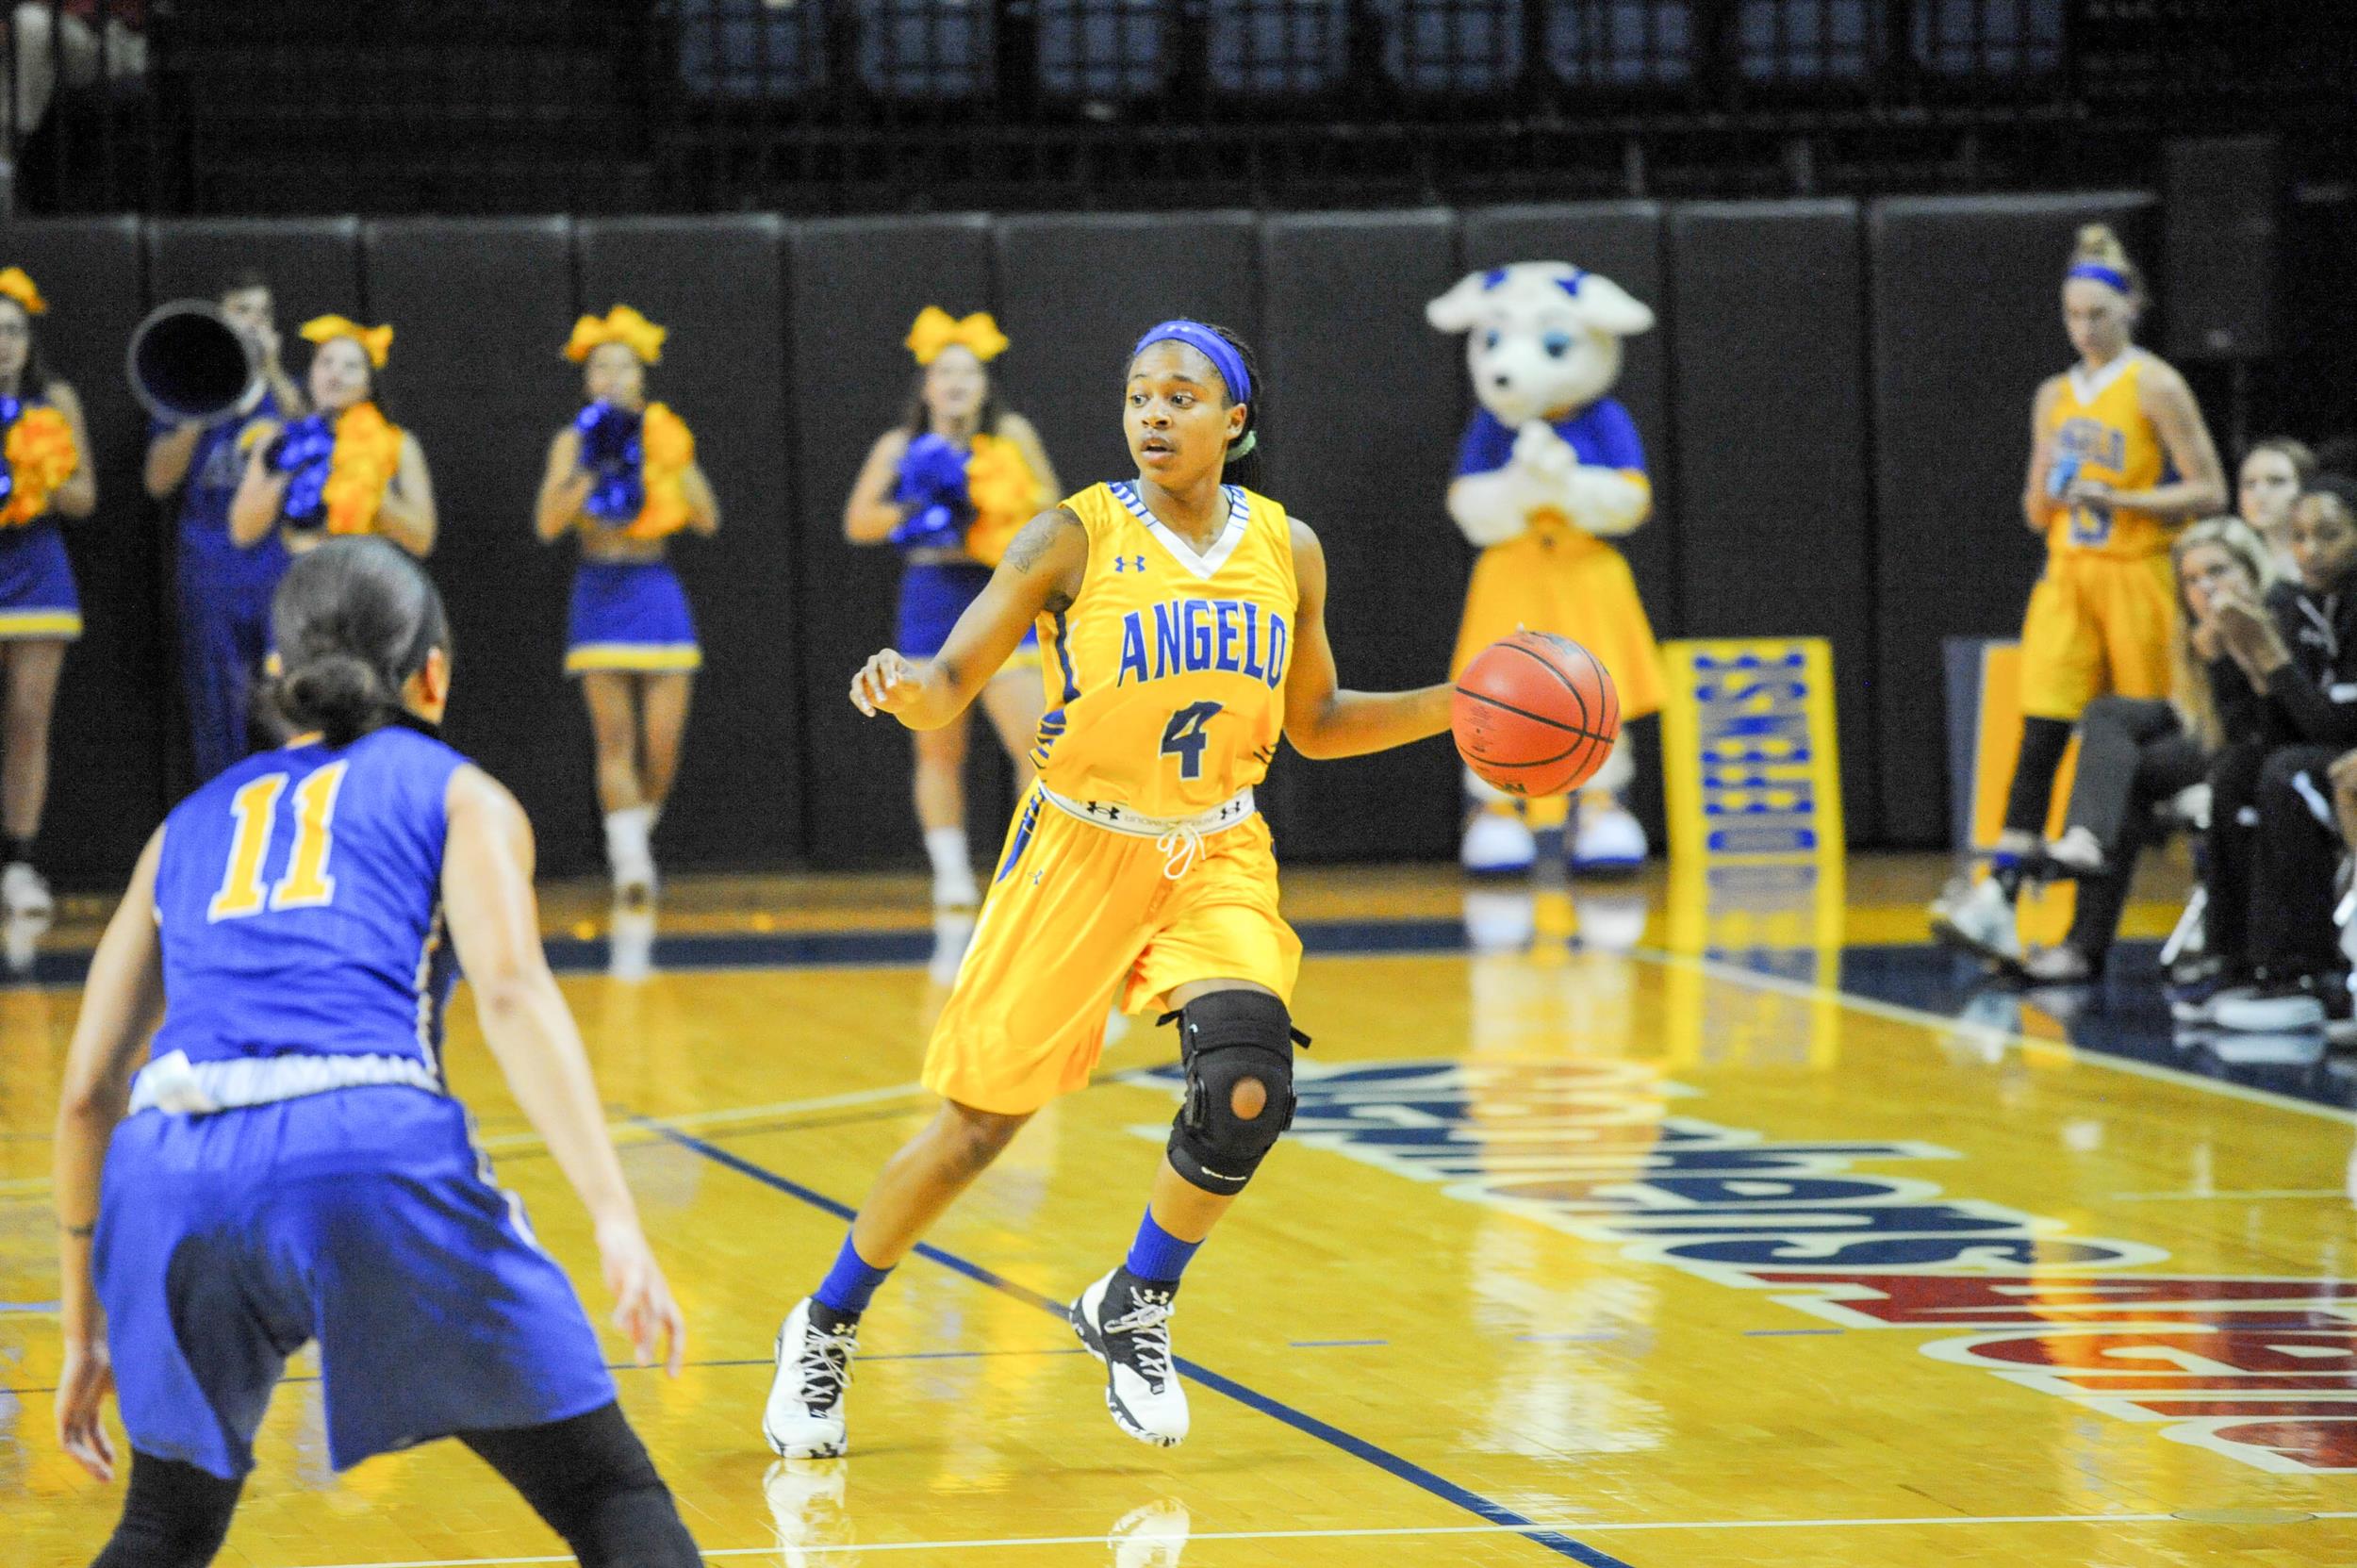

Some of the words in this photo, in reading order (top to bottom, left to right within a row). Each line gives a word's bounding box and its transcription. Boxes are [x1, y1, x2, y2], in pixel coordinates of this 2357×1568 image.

[1116, 599, 1287, 691] ANGELO
[1159, 701, 1224, 781] 4
[1694, 652, 1817, 853] DEFENSE
[206, 758, 349, 925] 11
